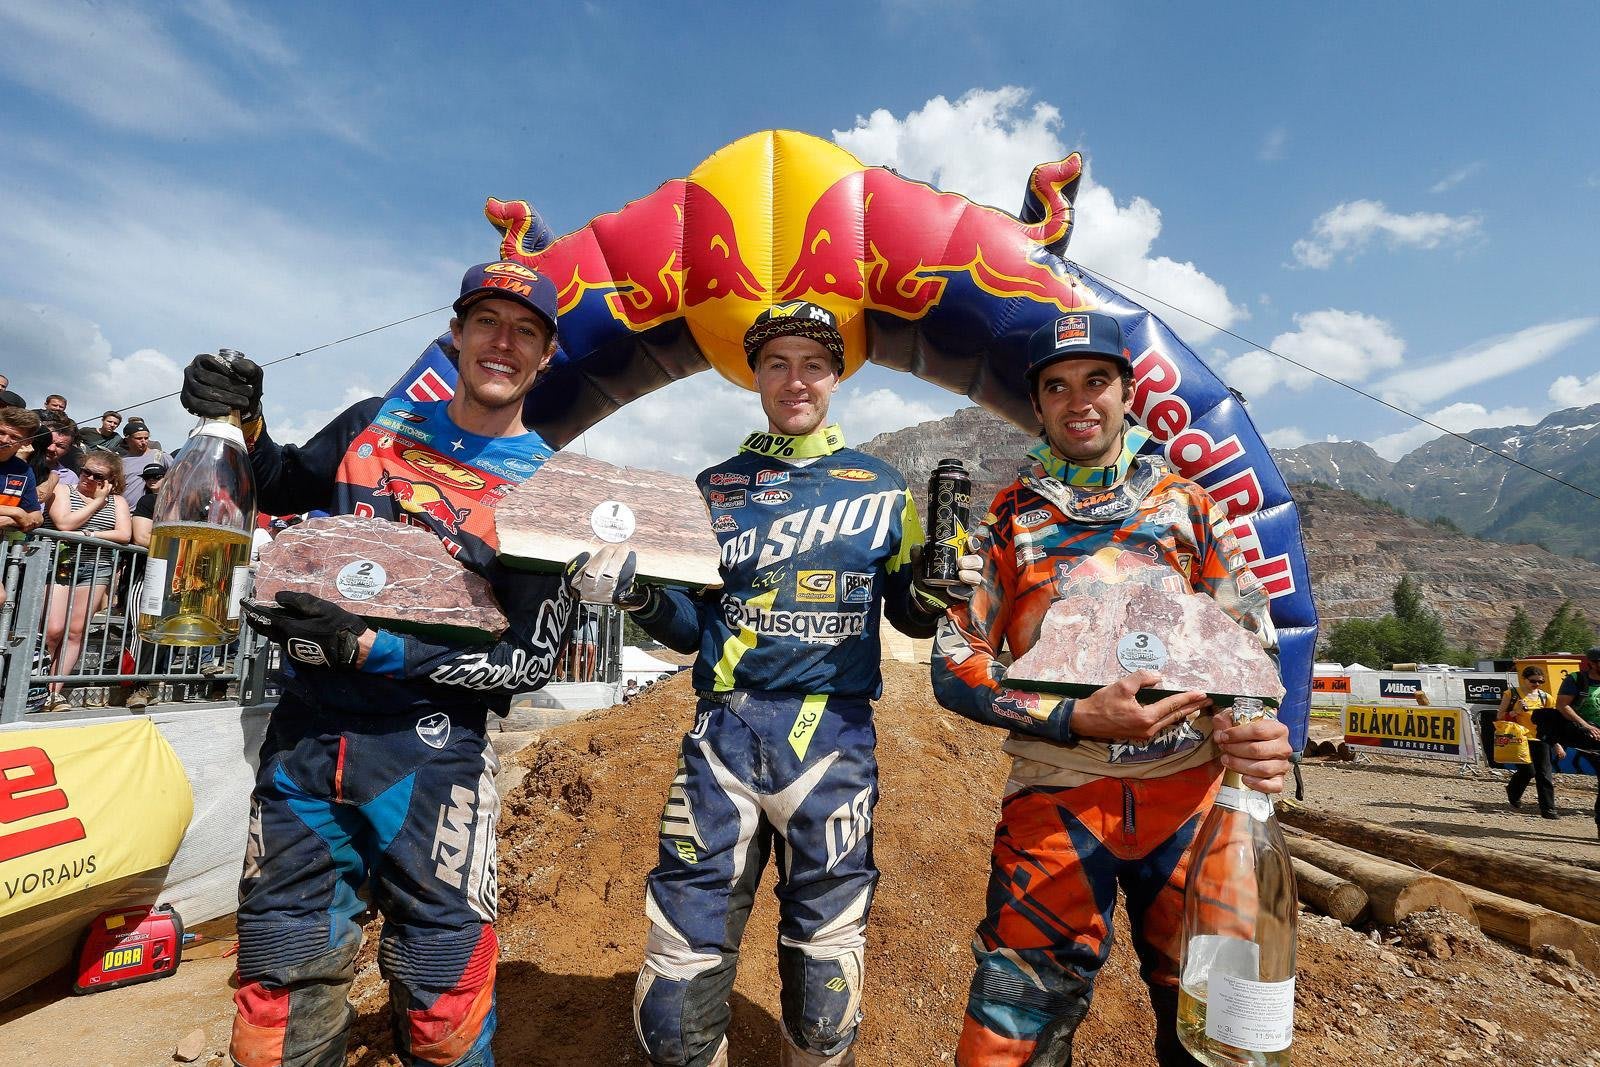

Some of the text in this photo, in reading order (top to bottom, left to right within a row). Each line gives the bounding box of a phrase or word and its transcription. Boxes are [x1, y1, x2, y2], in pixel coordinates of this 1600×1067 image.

[482, 277, 533, 297] KTM
[1125, 345, 1247, 482] Red
[391, 421, 430, 441] MOTOREX
[744, 432, 795, 457] 100%
[760, 472, 785, 483] 100%
[612, 504, 619, 517] 1
[757, 490, 906, 570] SHOT
[356, 562, 374, 576] 2
[746, 608, 864, 638] Husqvarn
[1135, 634, 1149, 648] 3
[1331, 680, 1347, 691] KTM
[1384, 682, 1417, 694] Mitas
[1468, 684, 1501, 693] GoPro
[1350, 707, 1456, 741] BLÅKLÄDER
[1393, 740, 1445, 752] WORKWEAR
[430, 784, 476, 890] KTM
[4, 855, 97, 899] VORAUS
